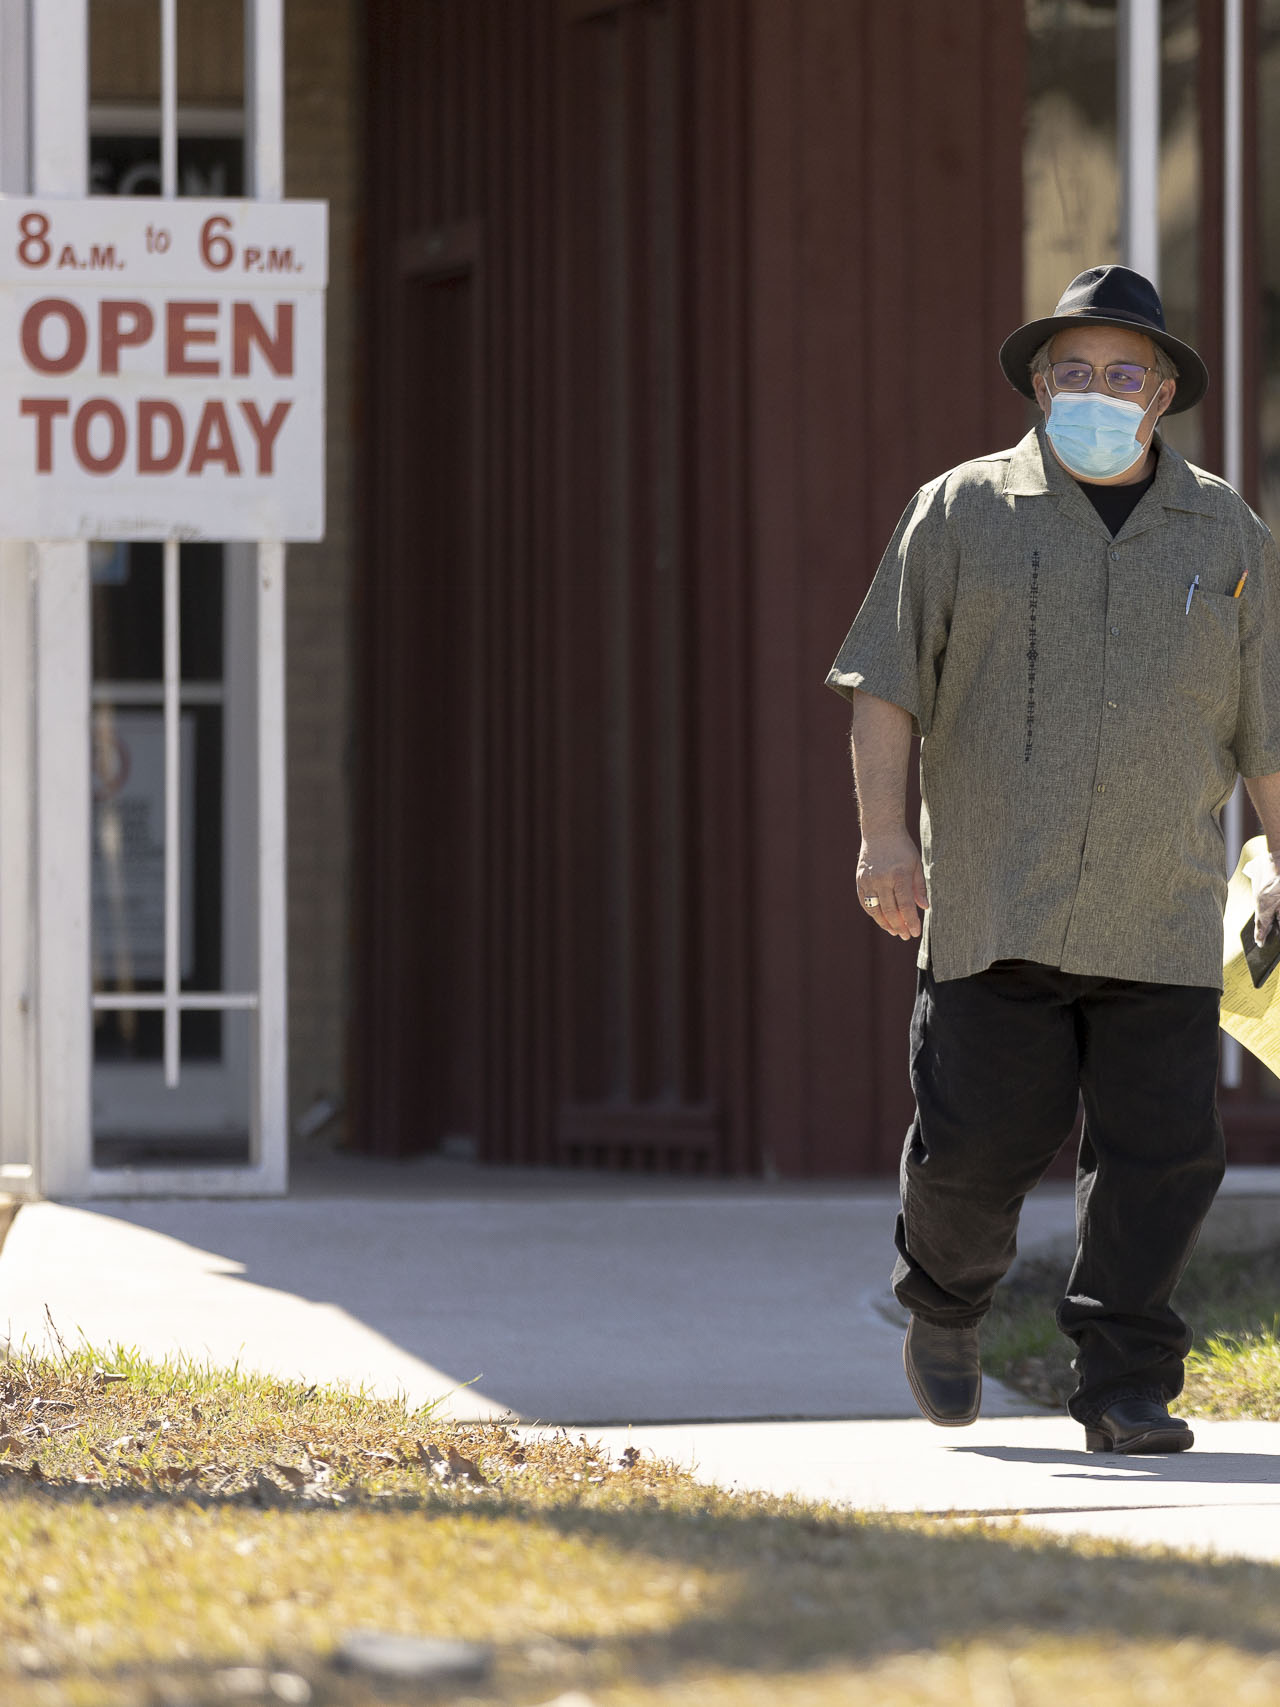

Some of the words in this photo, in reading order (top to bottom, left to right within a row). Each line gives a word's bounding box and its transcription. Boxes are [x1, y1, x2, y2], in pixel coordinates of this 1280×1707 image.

[17, 212, 52, 269] 8
[57, 244, 125, 270] A.M.
[145, 222, 171, 254] to
[199, 215, 235, 272] 6
[243, 247, 304, 273] P.M.
[19, 297, 295, 379] OPEN
[19, 397, 293, 477] TODAY
